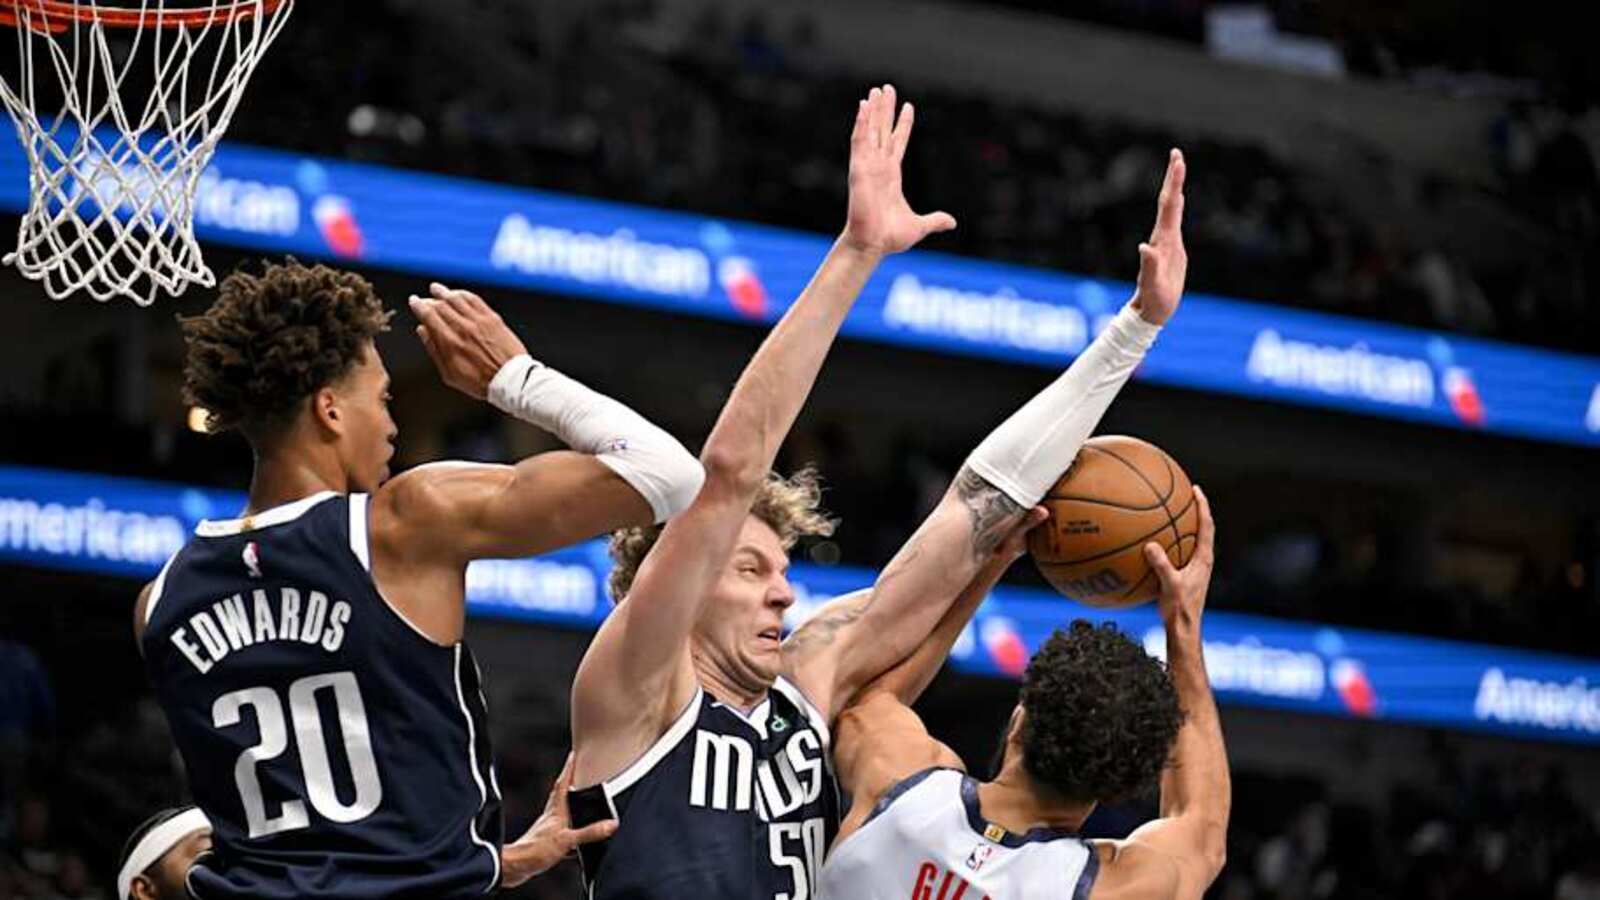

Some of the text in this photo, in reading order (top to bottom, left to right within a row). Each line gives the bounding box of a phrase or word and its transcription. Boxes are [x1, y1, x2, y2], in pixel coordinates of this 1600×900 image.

[490, 213, 711, 298] American
[883, 273, 1088, 355] American
[1246, 329, 1434, 408] American
[0, 498, 186, 565] merican
[170, 587, 352, 675] EDWARDS
[1473, 666, 1600, 733] Americ
[212, 671, 383, 839] 20
